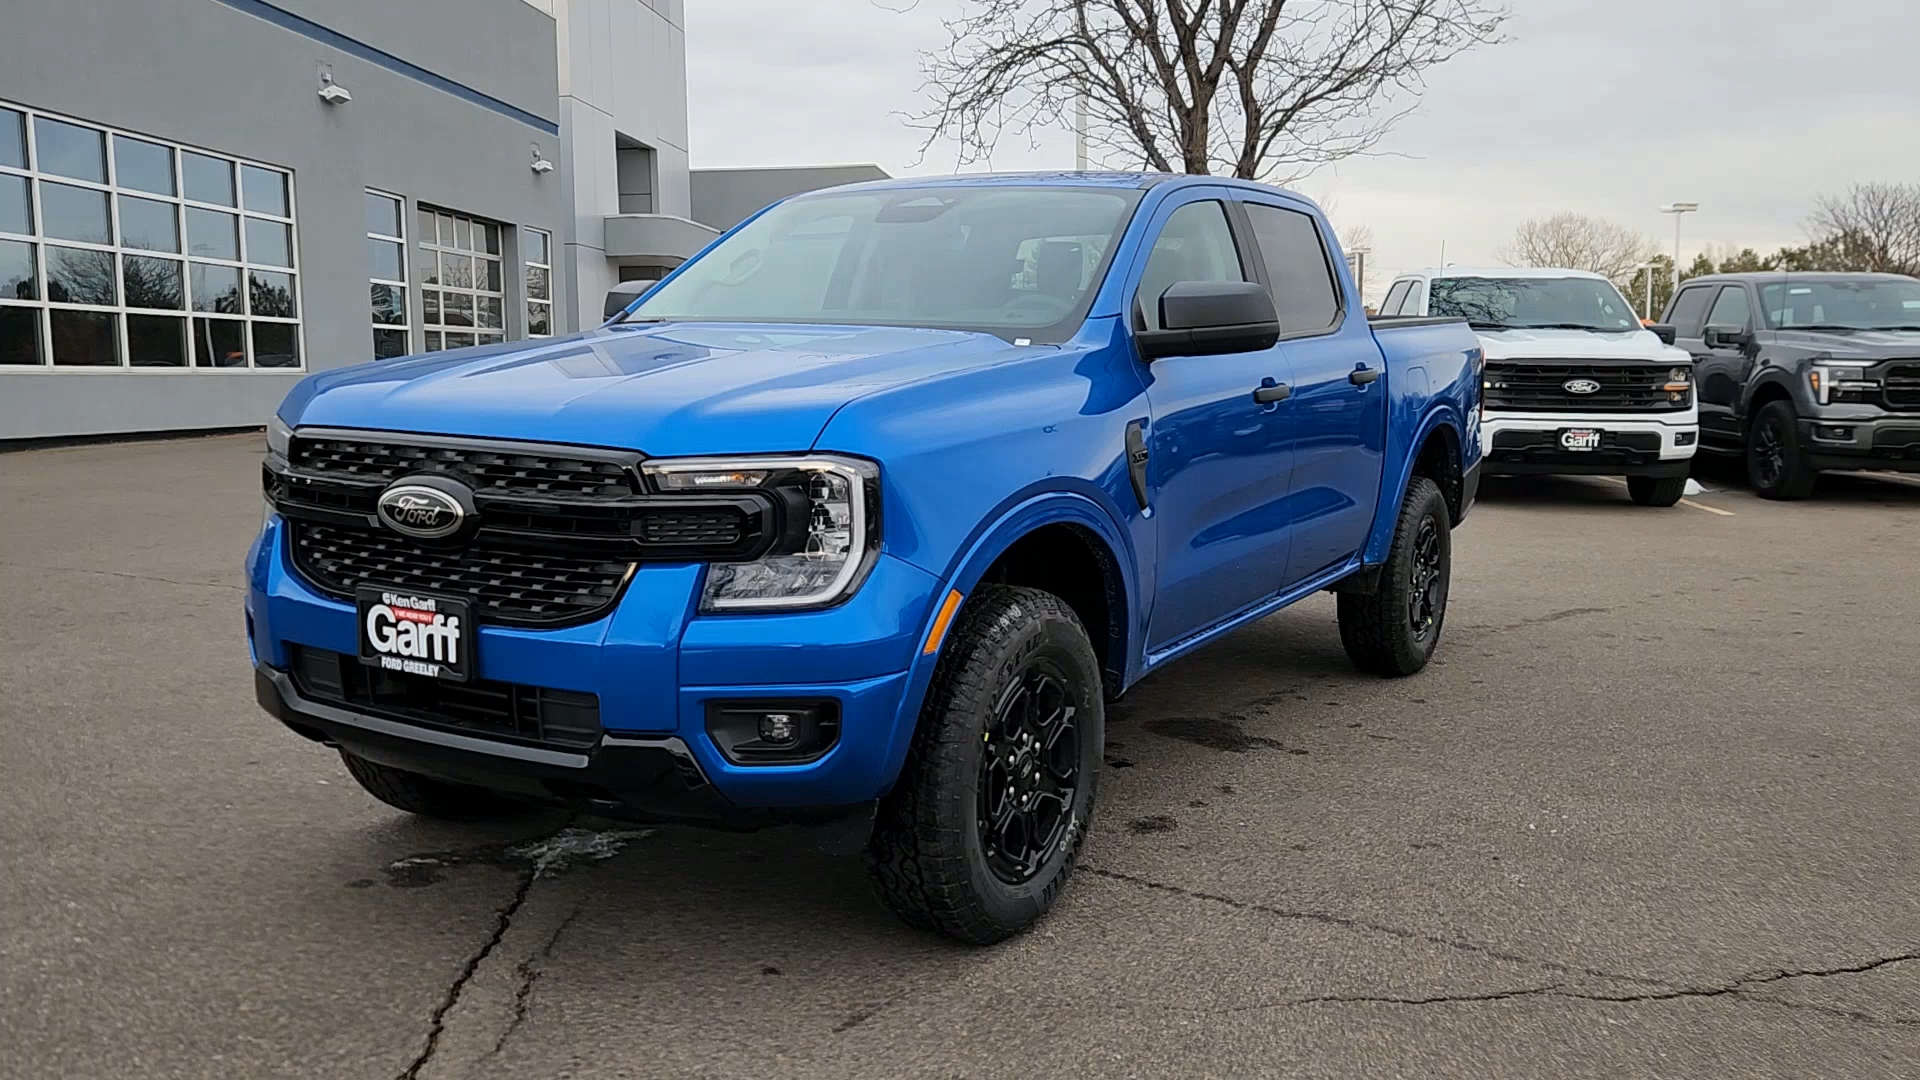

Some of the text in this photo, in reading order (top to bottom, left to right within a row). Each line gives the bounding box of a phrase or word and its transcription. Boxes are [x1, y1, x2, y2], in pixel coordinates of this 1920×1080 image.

[1561, 432, 1600, 447] Garff
[394, 495, 440, 525] Ford
[390, 593, 436, 612] Ken Garff
[366, 604, 460, 664] Garff
[381, 655, 439, 677] FORD GREELEY
